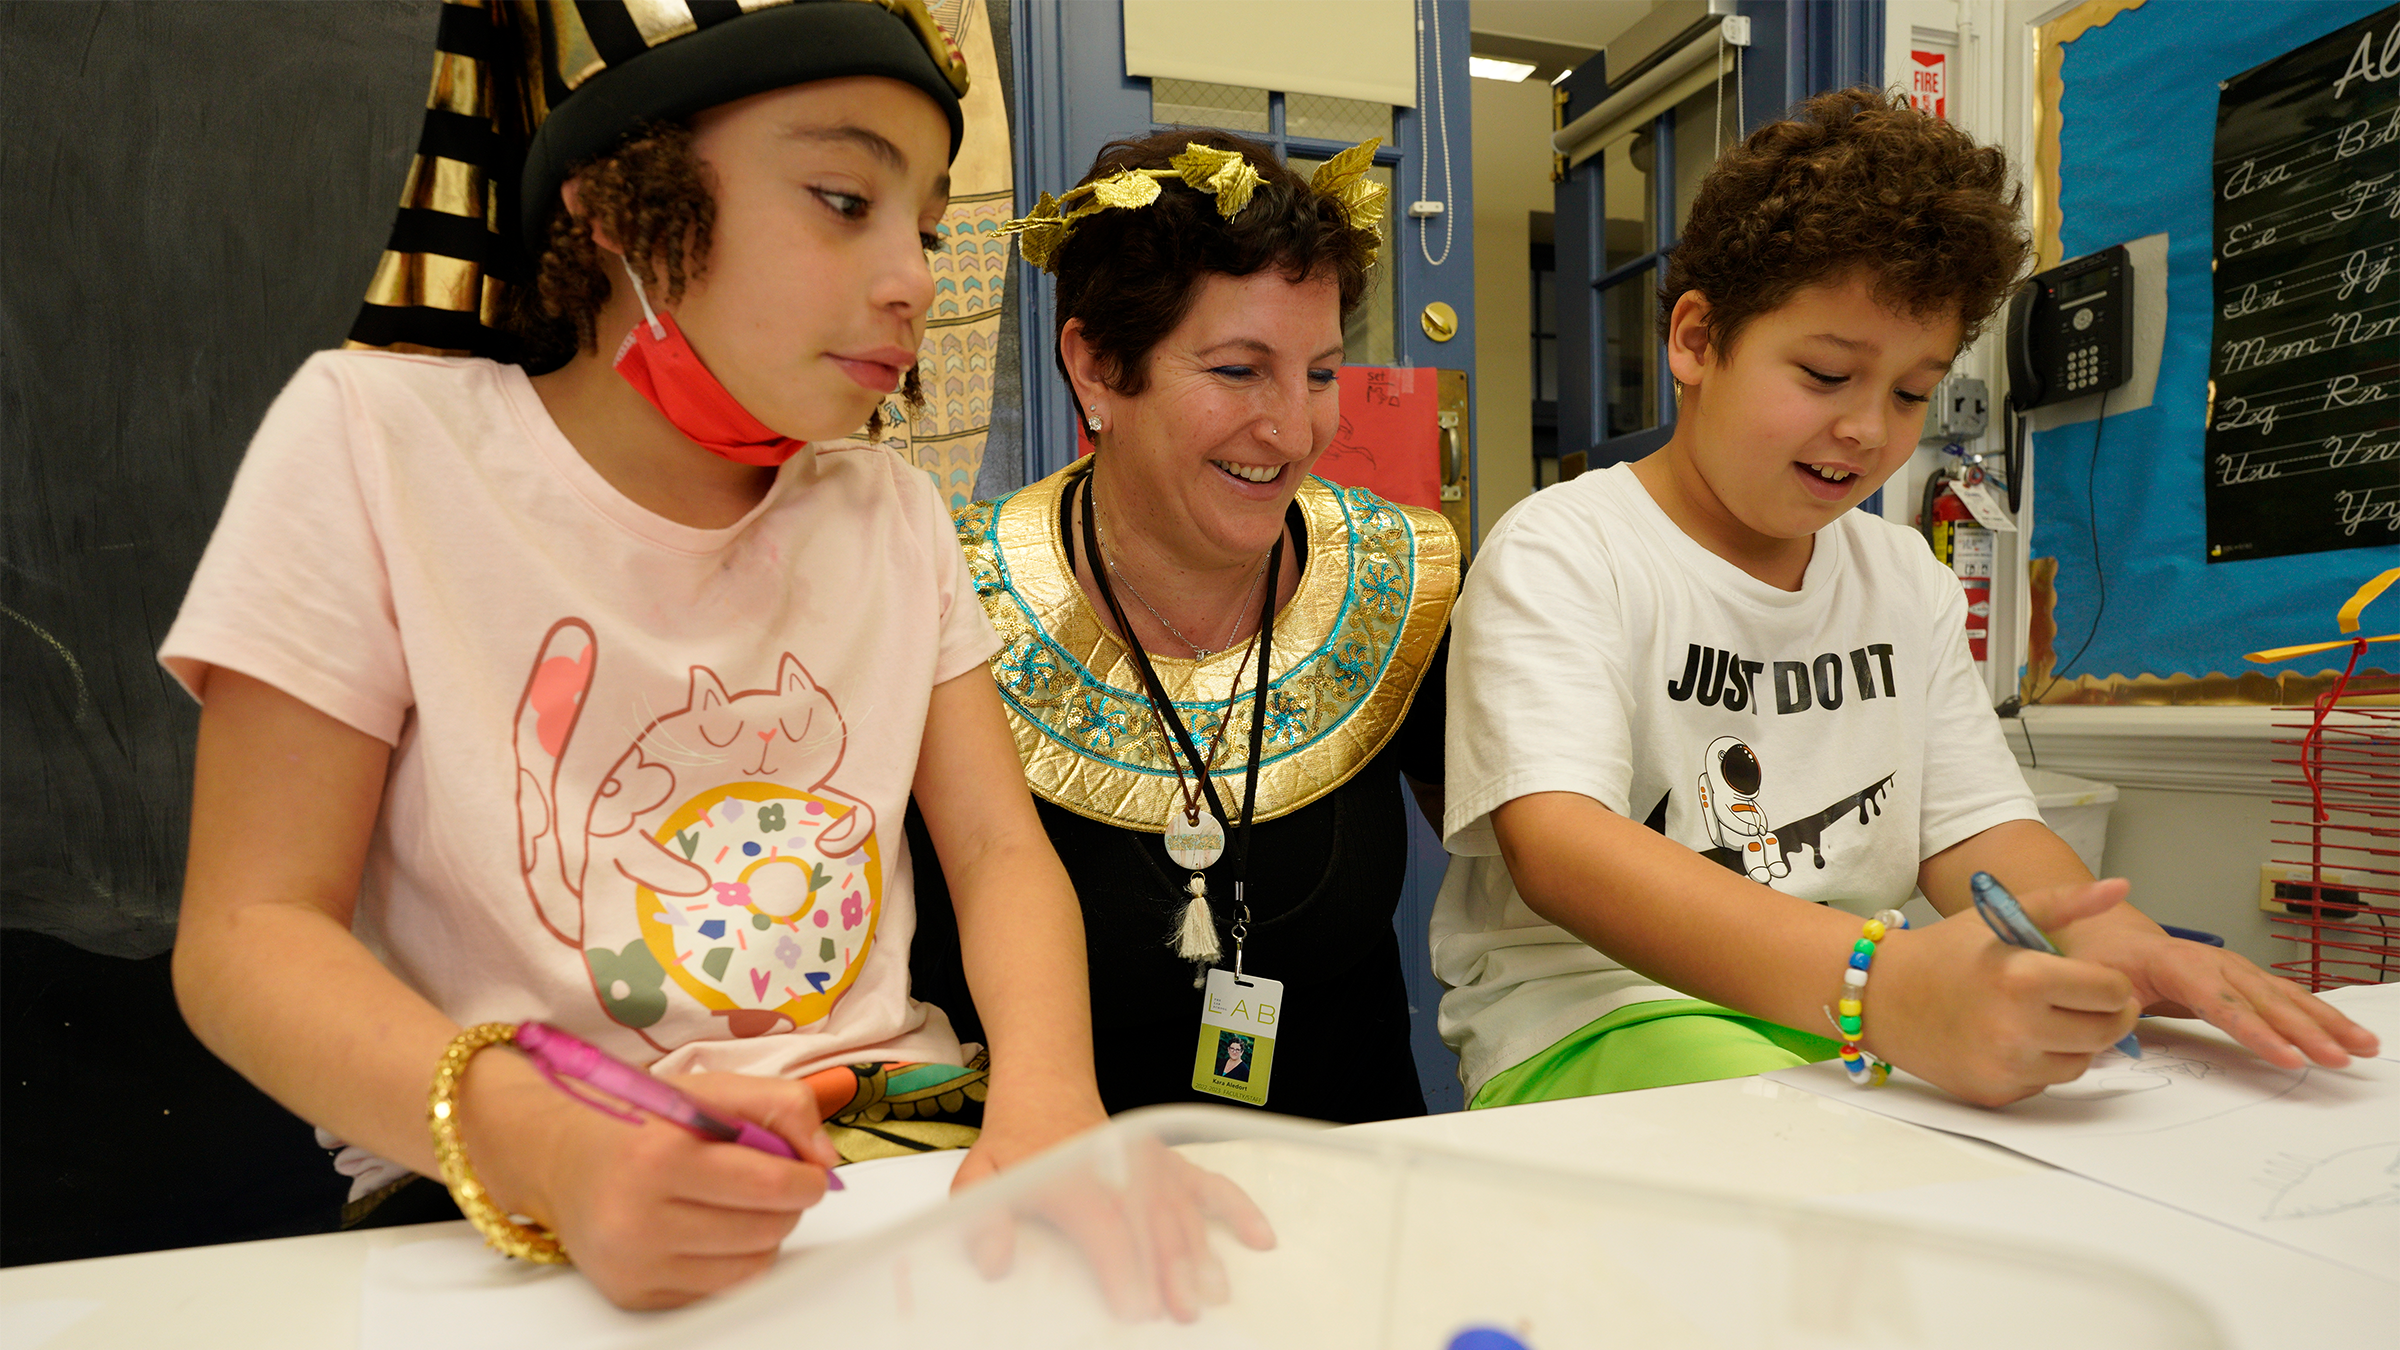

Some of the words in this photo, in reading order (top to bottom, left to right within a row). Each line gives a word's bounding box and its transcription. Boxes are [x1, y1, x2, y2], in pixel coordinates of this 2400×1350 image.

[1913, 70, 1939, 93] FIRE
[2223, 161, 2292, 200] Aa
[2222, 222, 2277, 258] Ee
[2337, 246, 2395, 301] Jj
[2224, 337, 2322, 374] Mm
[2324, 374, 2389, 411] Rr
[2217, 453, 2282, 485] Uu
[2337, 489, 2400, 537] Yy
[1667, 643, 1765, 716] JUST
[1773, 652, 1844, 715] DO
[1850, 643, 1897, 701] IT
[1212, 1078, 1225, 1087] Kara
[1226, 1081, 1248, 1092] Aledort
[1223, 1089, 1262, 1103] FACULTY/STAFF
